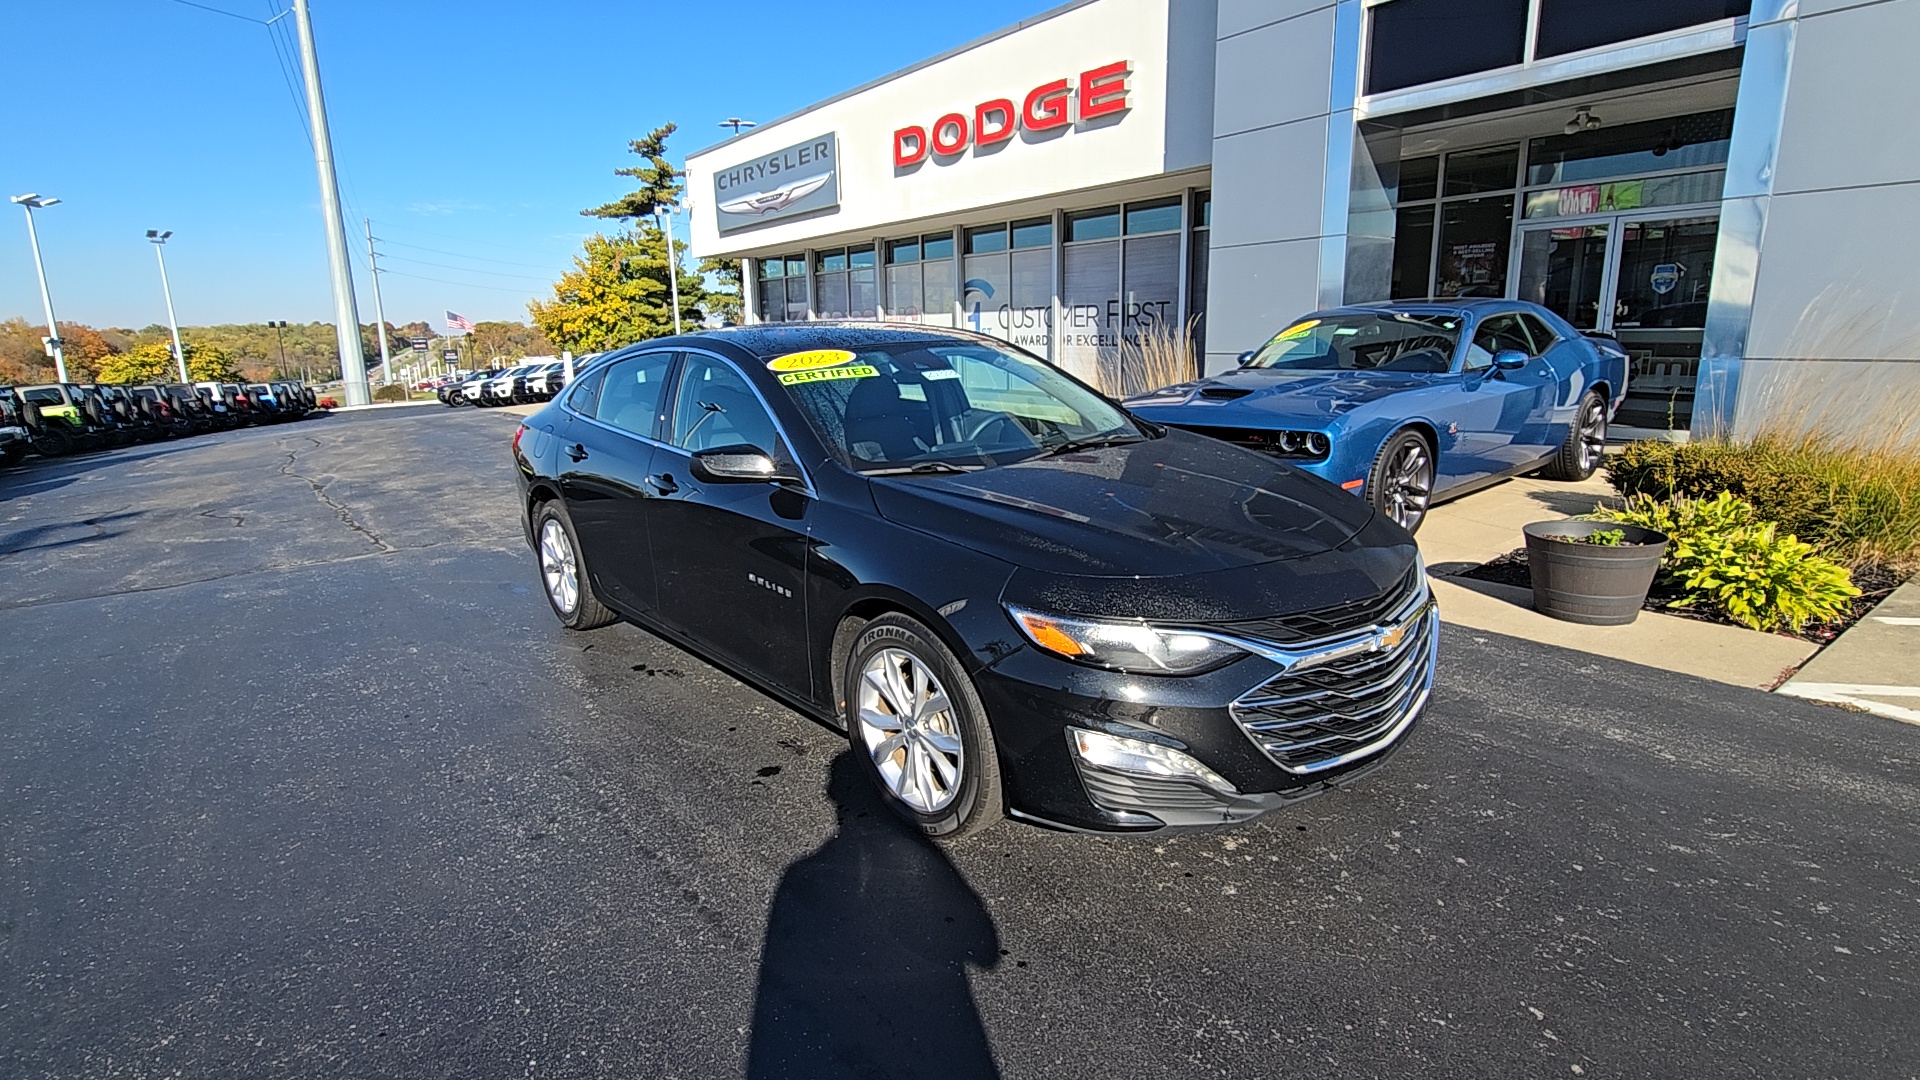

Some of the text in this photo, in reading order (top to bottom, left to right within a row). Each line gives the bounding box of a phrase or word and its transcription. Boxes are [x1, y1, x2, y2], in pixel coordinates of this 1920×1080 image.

[894, 60, 1133, 167] DODGE
[717, 141, 829, 190] CHRYSLER
[1106, 299, 1171, 328] FIRST
[1014, 334, 1049, 346] AWARD
[785, 352, 840, 368] 2023
[782, 366, 873, 383] CERTIFIED
